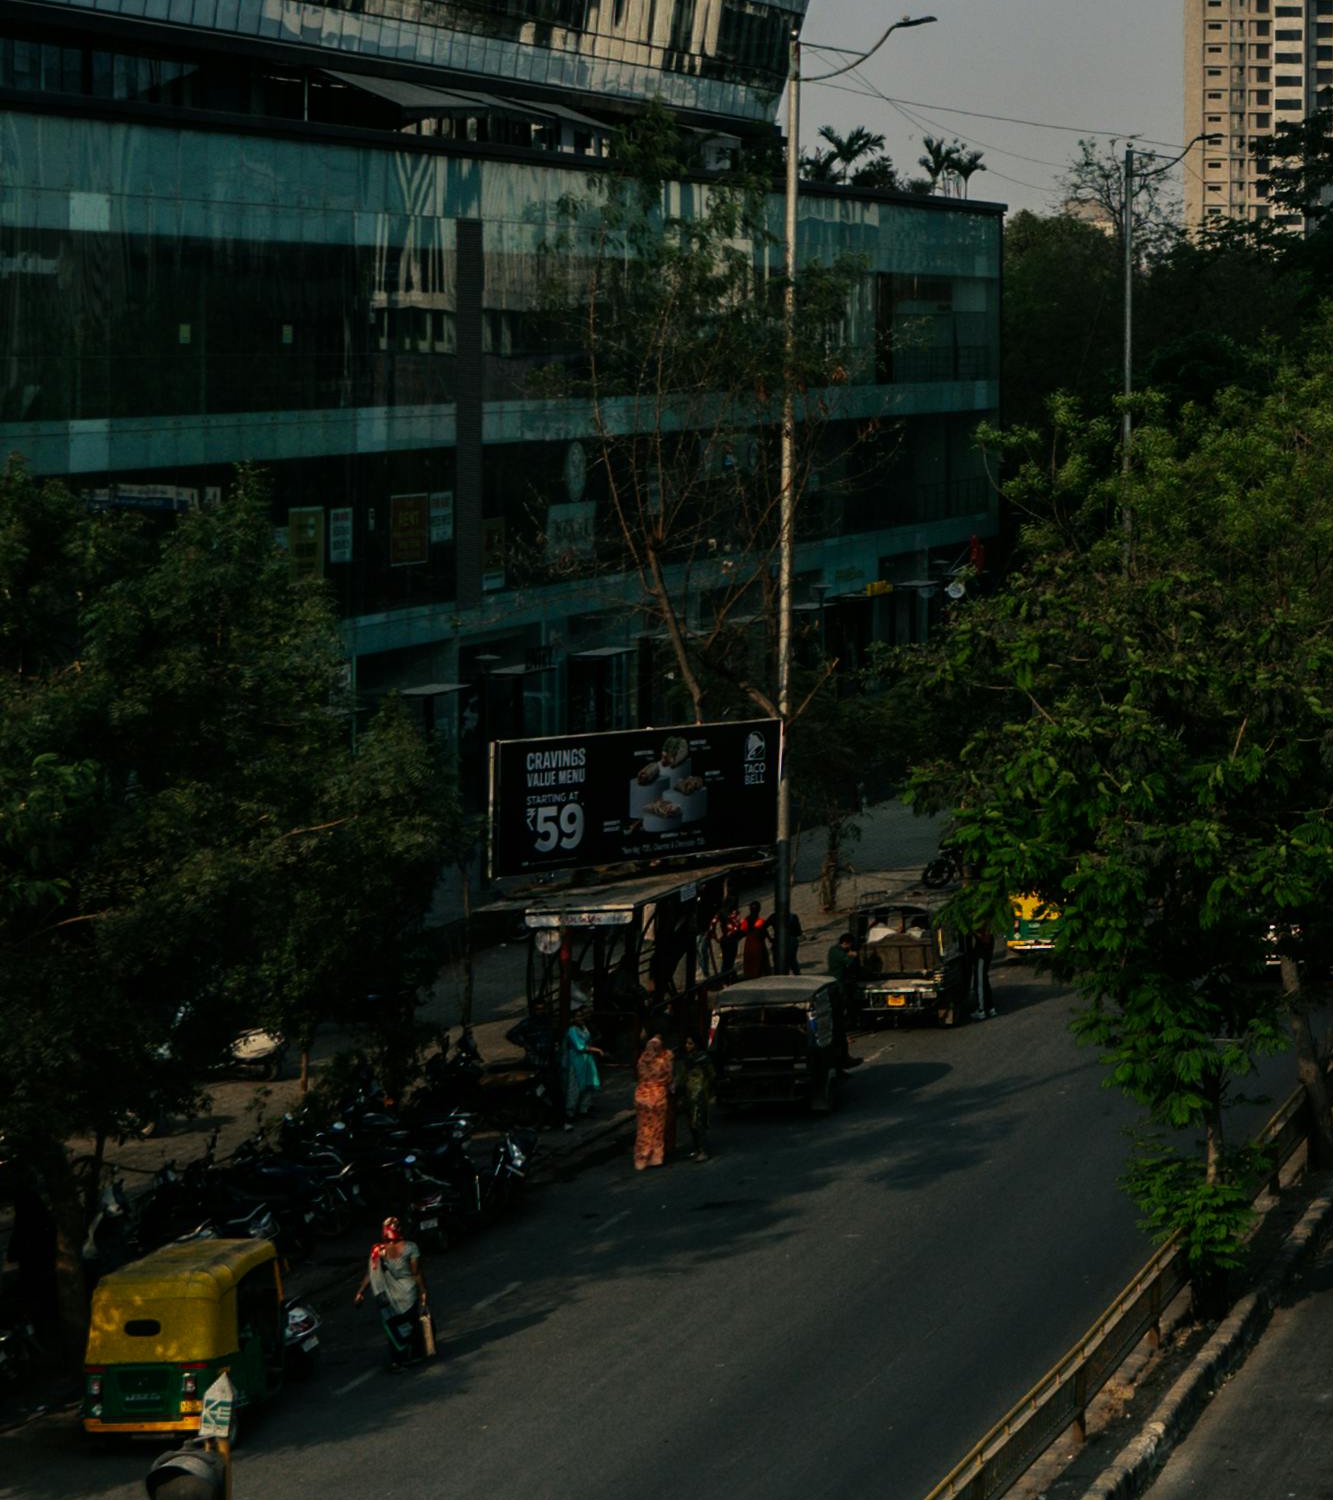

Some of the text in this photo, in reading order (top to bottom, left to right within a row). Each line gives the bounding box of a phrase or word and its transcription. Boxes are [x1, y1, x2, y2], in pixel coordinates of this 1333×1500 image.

[526, 747, 587, 771] CRAVINGS
[744, 762, 767, 774] TACO
[526, 768, 586, 788] VALUE MENU
[744, 773, 766, 785] BELL
[526, 791, 580, 806] STARTING AT
